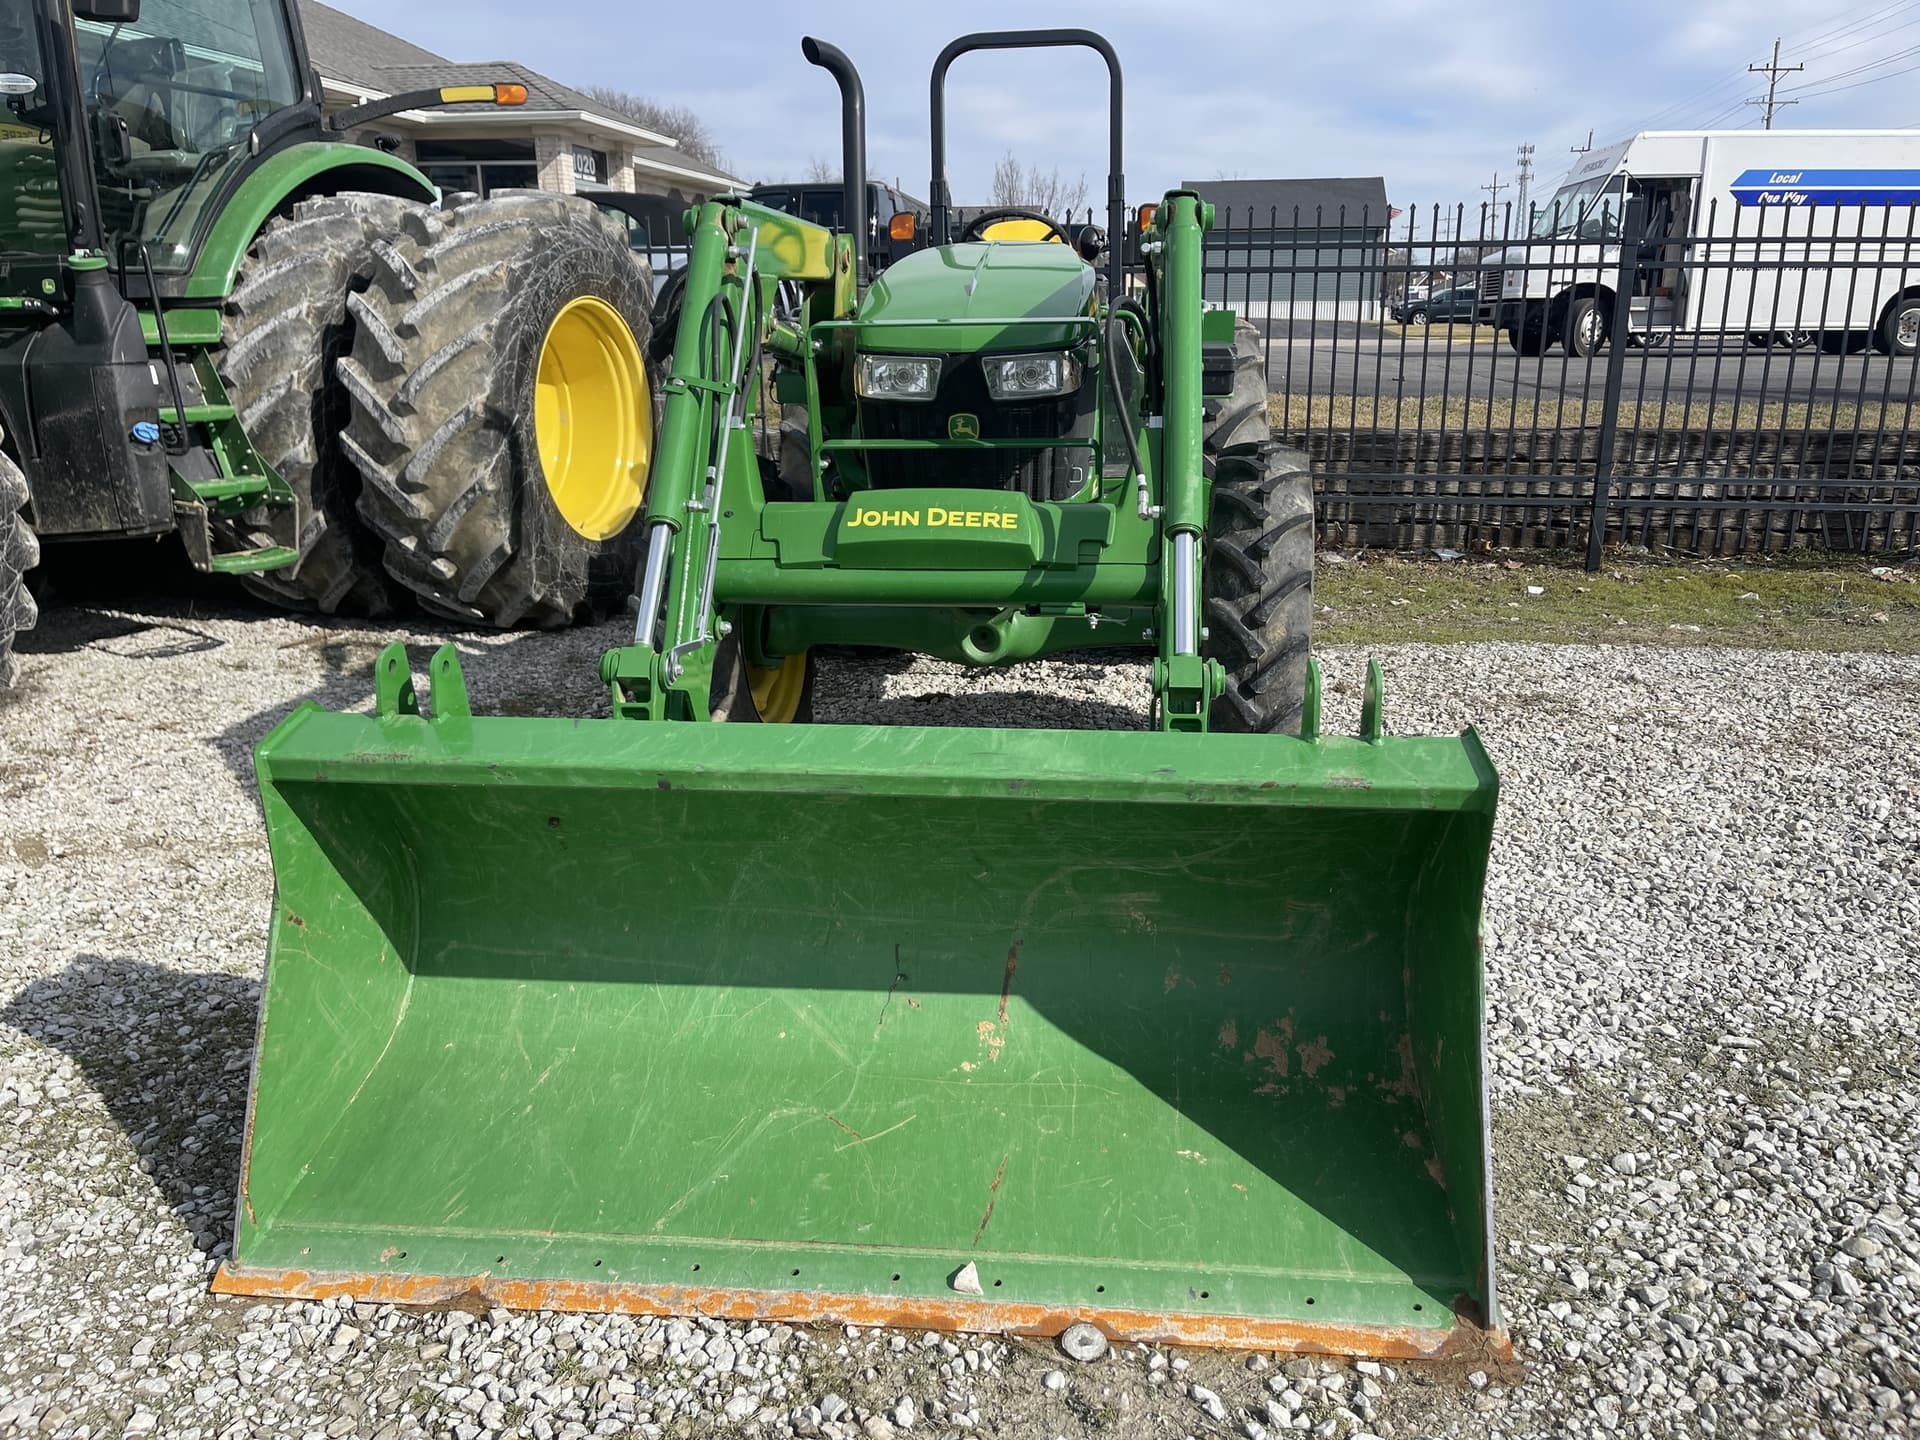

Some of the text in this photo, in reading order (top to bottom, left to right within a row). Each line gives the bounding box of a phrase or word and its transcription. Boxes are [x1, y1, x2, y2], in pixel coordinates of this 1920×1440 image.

[1768, 171, 1803, 184] Local
[1782, 191, 1808, 206] Way
[847, 507, 1018, 529] JOHN DEERE
